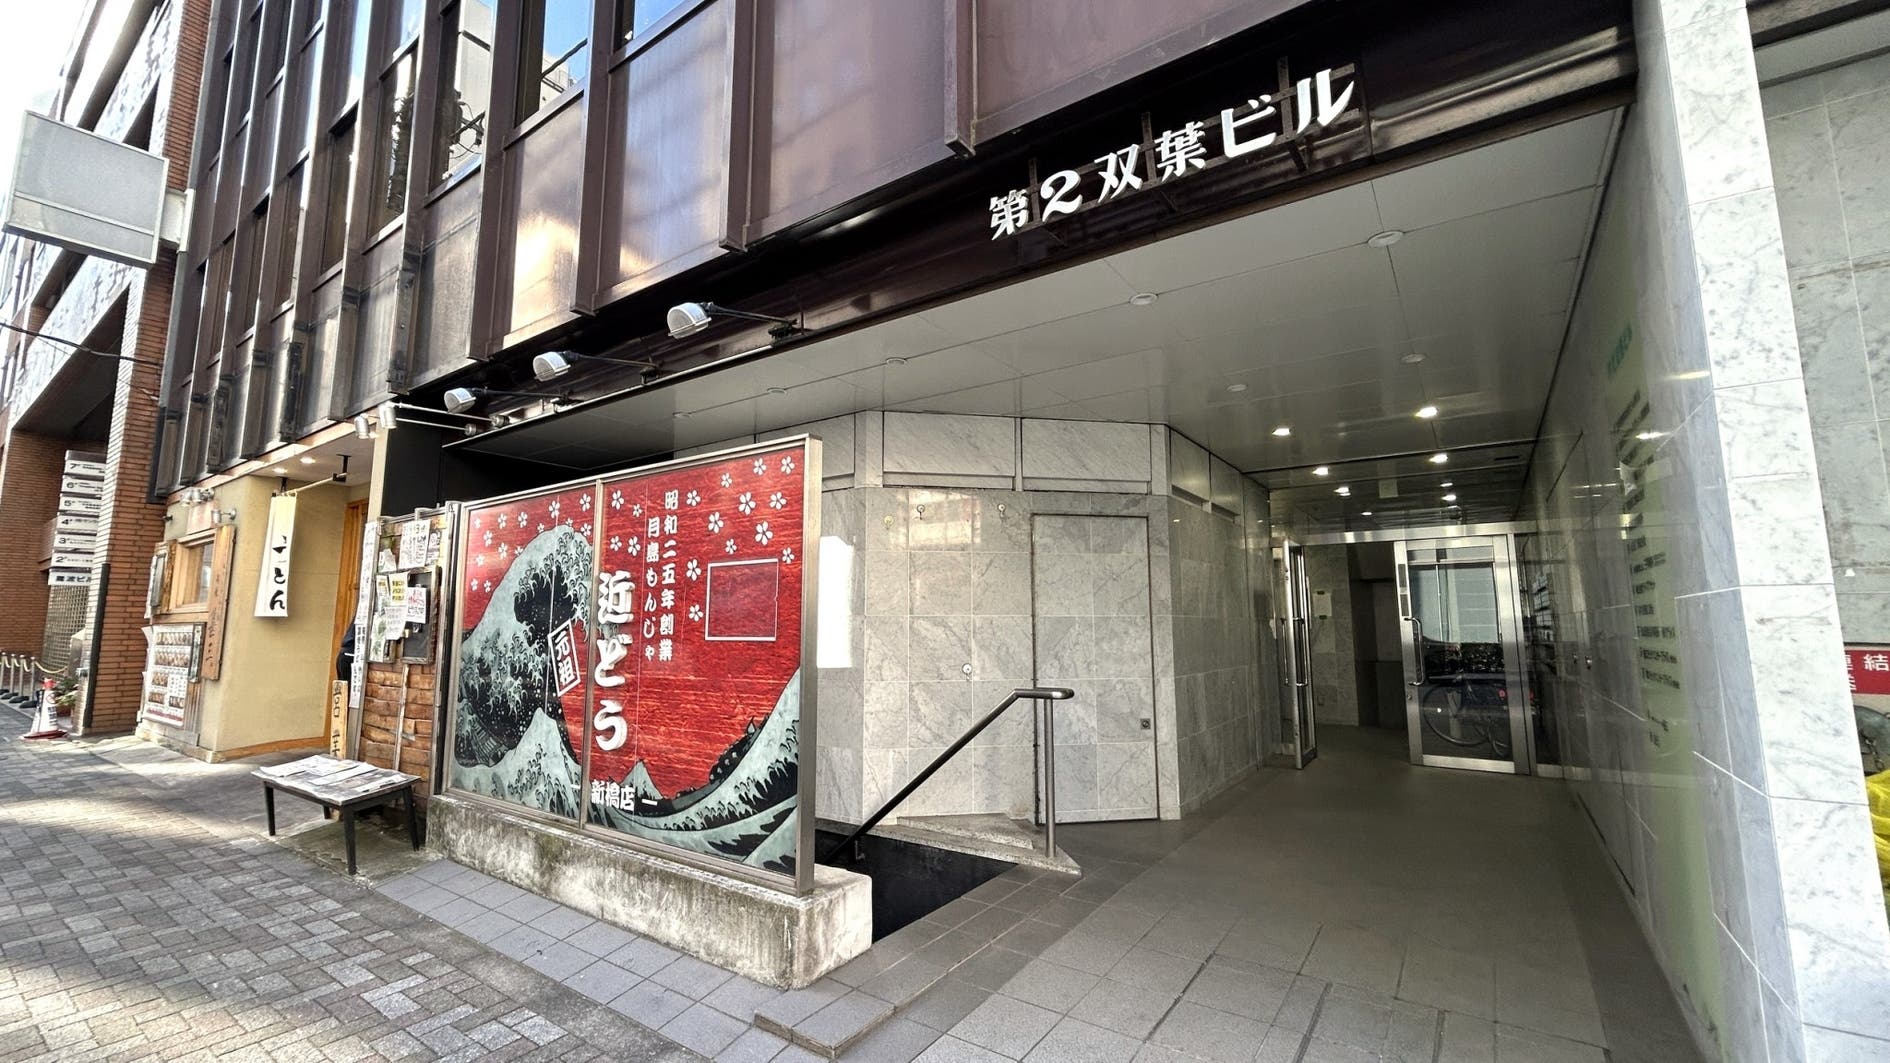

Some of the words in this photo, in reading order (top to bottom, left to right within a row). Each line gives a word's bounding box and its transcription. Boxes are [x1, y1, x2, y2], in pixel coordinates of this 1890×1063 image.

[988, 68, 1355, 241] 第2双葉ビル
[643, 517, 661, 661] 月島もんじゃ
[658, 489, 679, 661] 昭和二五年創業
[554, 630, 575, 685] 元祖
[594, 570, 635, 751] 近どう
[591, 779, 635, 812] 新橋店
